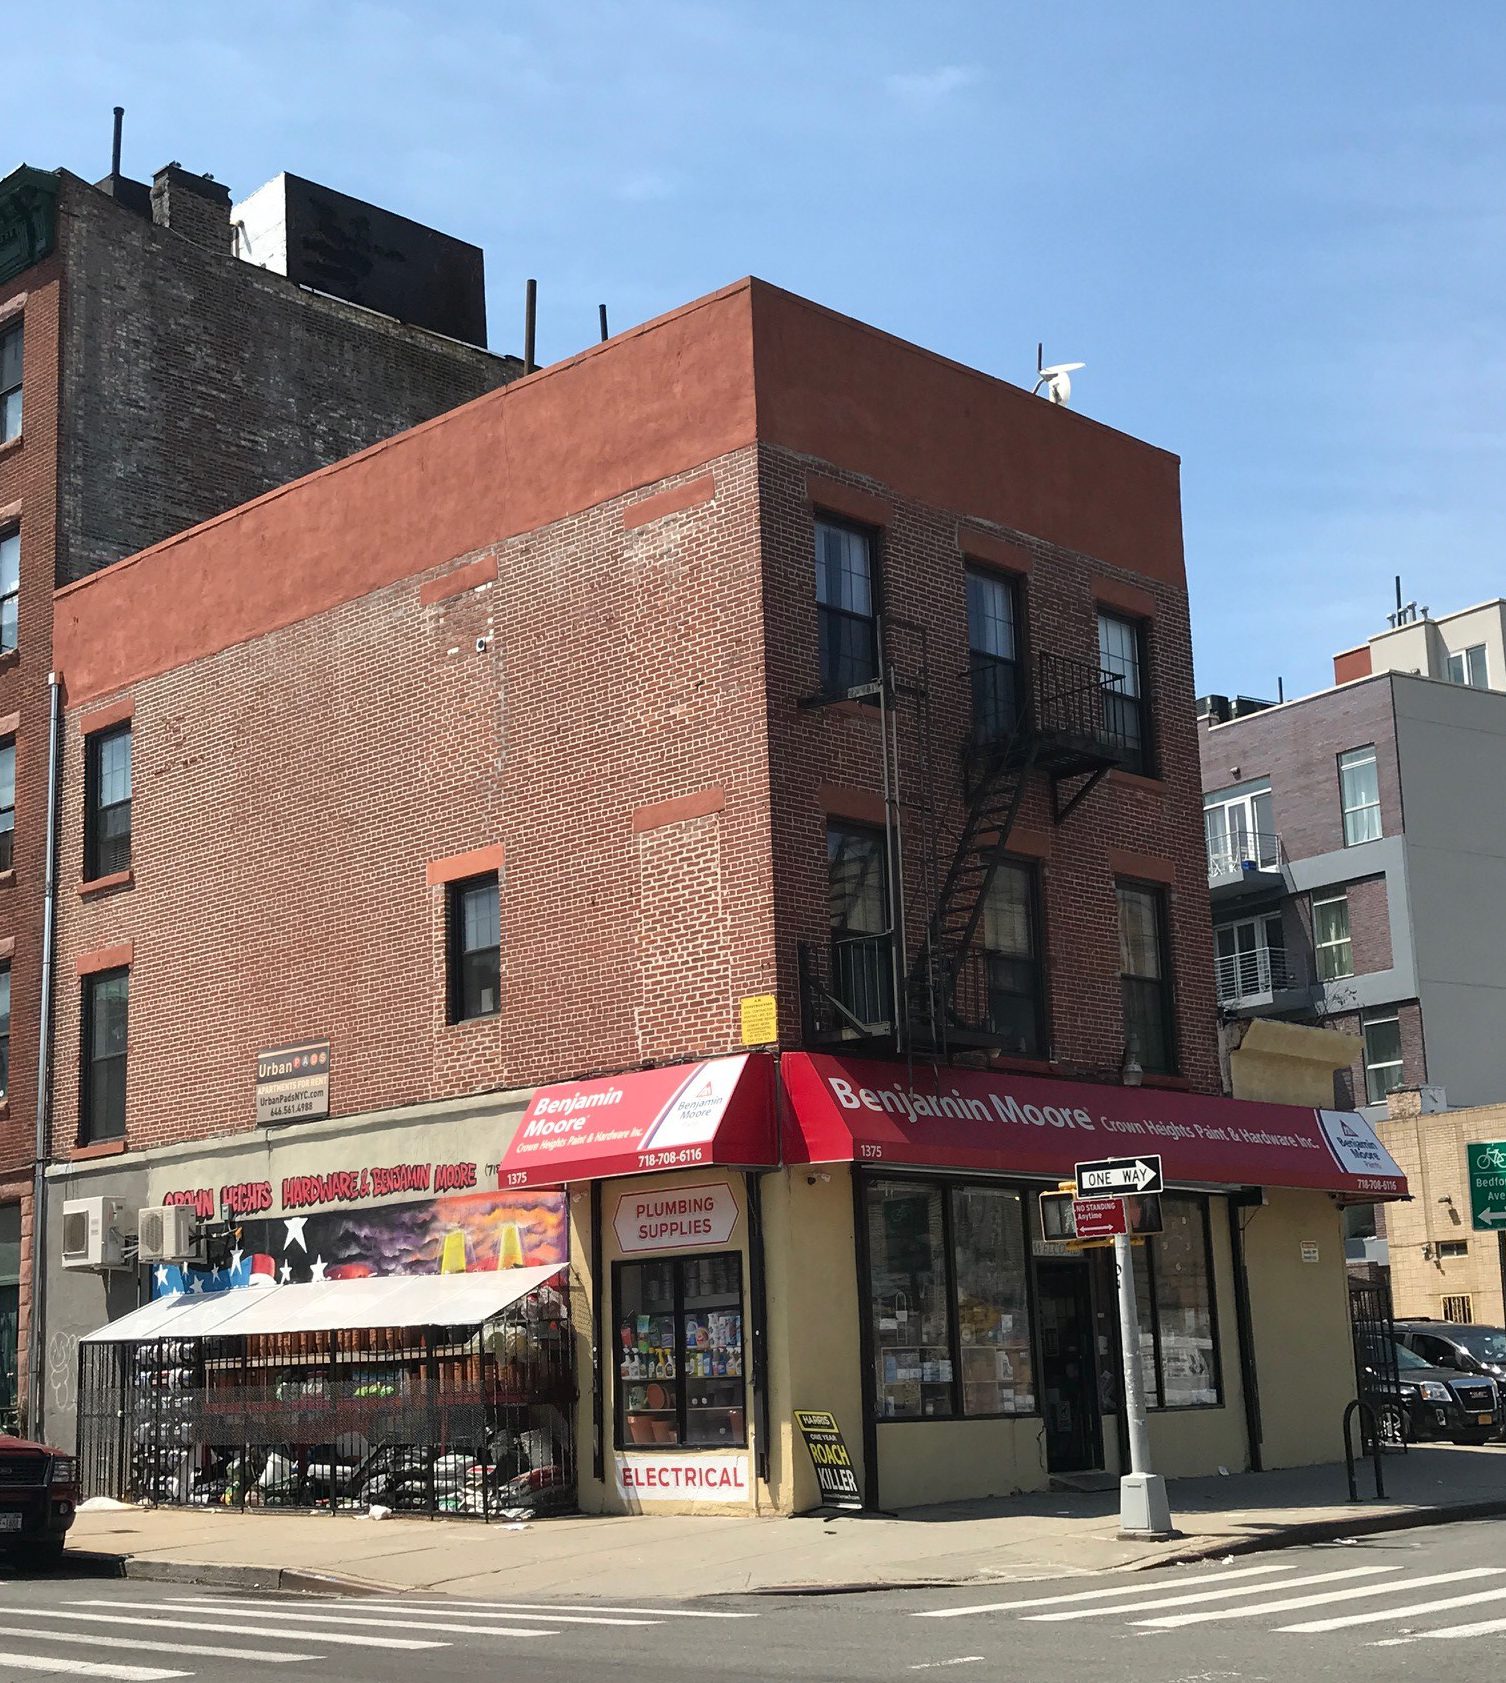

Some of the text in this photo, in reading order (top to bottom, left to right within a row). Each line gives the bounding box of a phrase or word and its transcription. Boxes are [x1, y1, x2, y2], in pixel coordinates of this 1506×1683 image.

[259, 1062, 292, 1078] Urban
[257, 1077, 328, 1095] APARTMENTS FOR RENT
[260, 1090, 324, 1106] UrbanPadsNYC.com
[534, 1087, 623, 1116] Benjamin
[678, 1096, 723, 1110] Benjamin
[680, 1109, 712, 1120] Moore
[828, 1077, 1320, 1149] Benjamin Moore Crown Heights Paint & Hardware Inc.
[524, 1116, 587, 1138] Moore
[516, 1127, 643, 1154] Crown Heights Paint & Hardware Inc.
[1336, 1136, 1378, 1150] Benjamin
[638, 1148, 702, 1167] 718-708-6116
[860, 1145, 882, 1158] 1375
[1350, 1149, 1380, 1160] Moore
[507, 1172, 527, 1185] 1375
[1088, 1168, 1147, 1186] ONE WAY
[1357, 1179, 1396, 1190] 718-708-6116
[1476, 1176, 1506, 1187] Bedfo
[282, 1171, 359, 1210] HARDWARE
[360, 1168, 370, 1198] &
[370, 1162, 431, 1198] BENJAMIN
[434, 1162, 477, 1194] MOORE
[1488, 1191, 1506, 1200] Ave
[636, 1197, 714, 1218] PLUMBING
[1076, 1202, 1116, 1212] NO STANDING
[1078, 1213, 1102, 1221] Anytime
[639, 1219, 711, 1239] SUPPLIES
[802, 1415, 831, 1426] HARRIS
[822, 1434, 837, 1442] YEAR
[809, 1443, 850, 1466] ROACH
[622, 1468, 744, 1487] ELECTRICAL
[817, 1467, 858, 1492] KILLER
